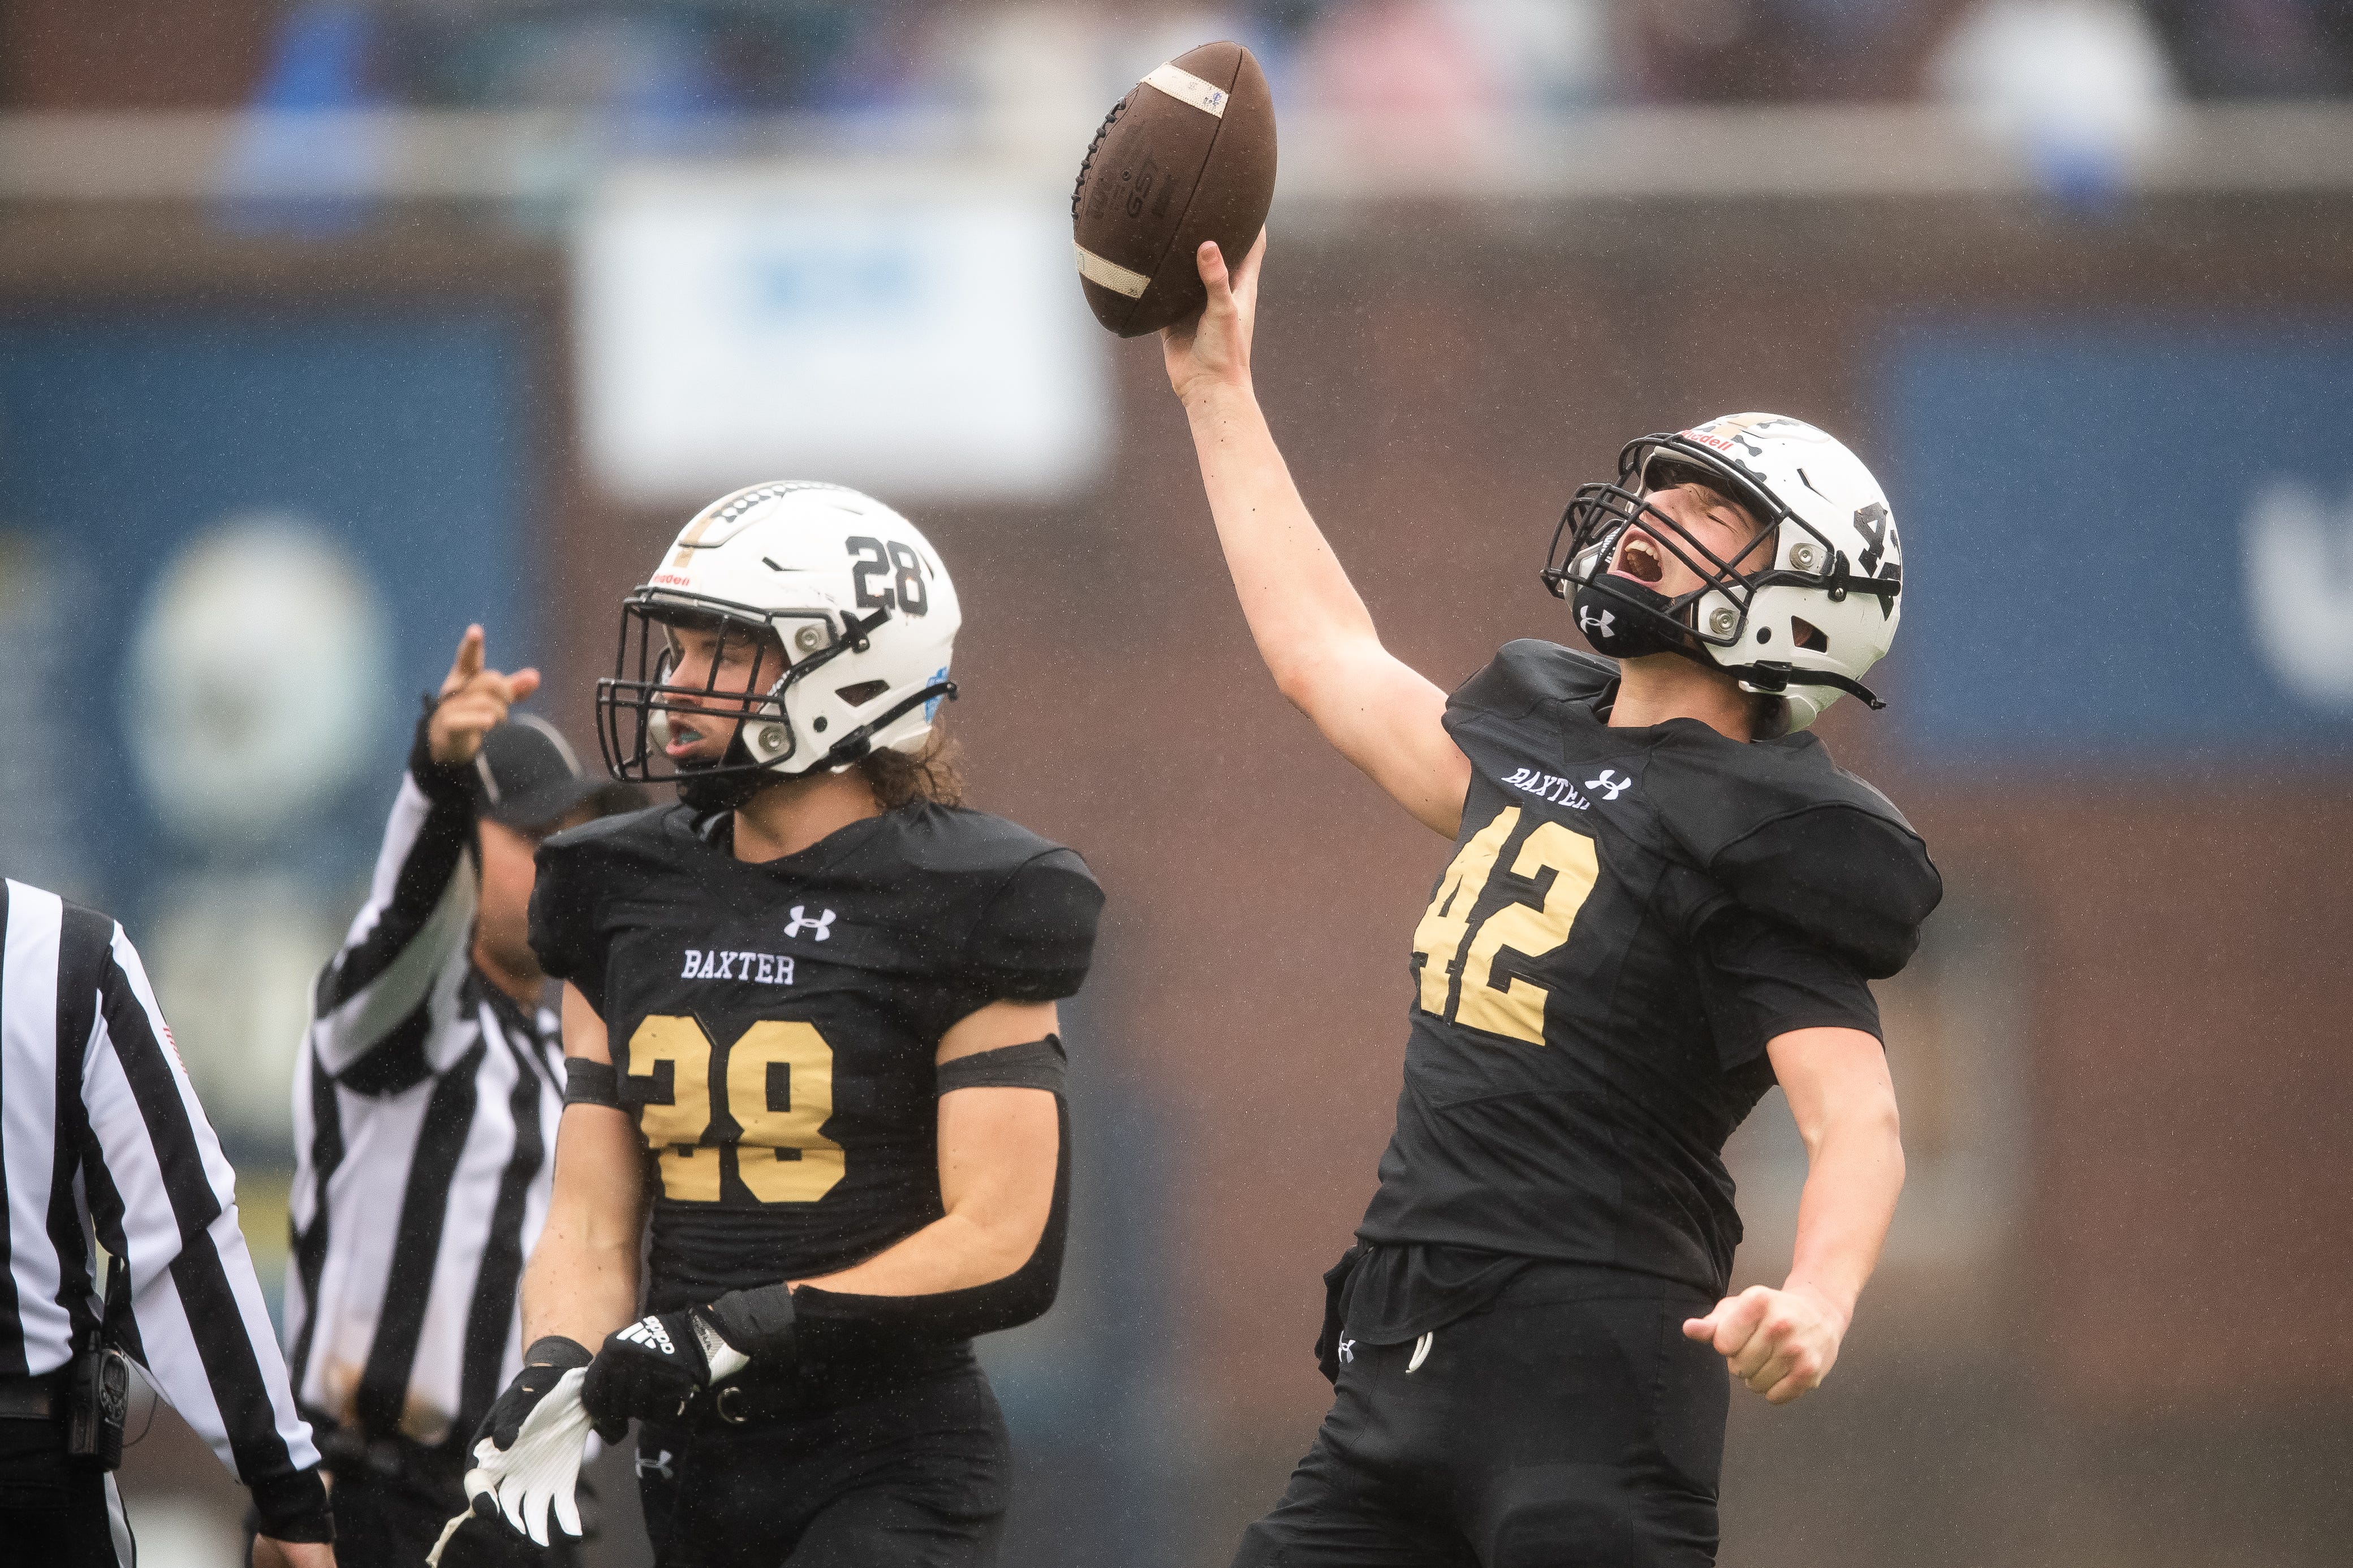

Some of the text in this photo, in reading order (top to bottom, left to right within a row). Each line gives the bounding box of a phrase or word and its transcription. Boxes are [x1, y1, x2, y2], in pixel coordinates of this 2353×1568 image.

[844, 536, 928, 617] 28
[680, 949, 795, 985] BAXTER
[1413, 805, 1600, 1046] 42
[628, 1014, 846, 1203] 28
